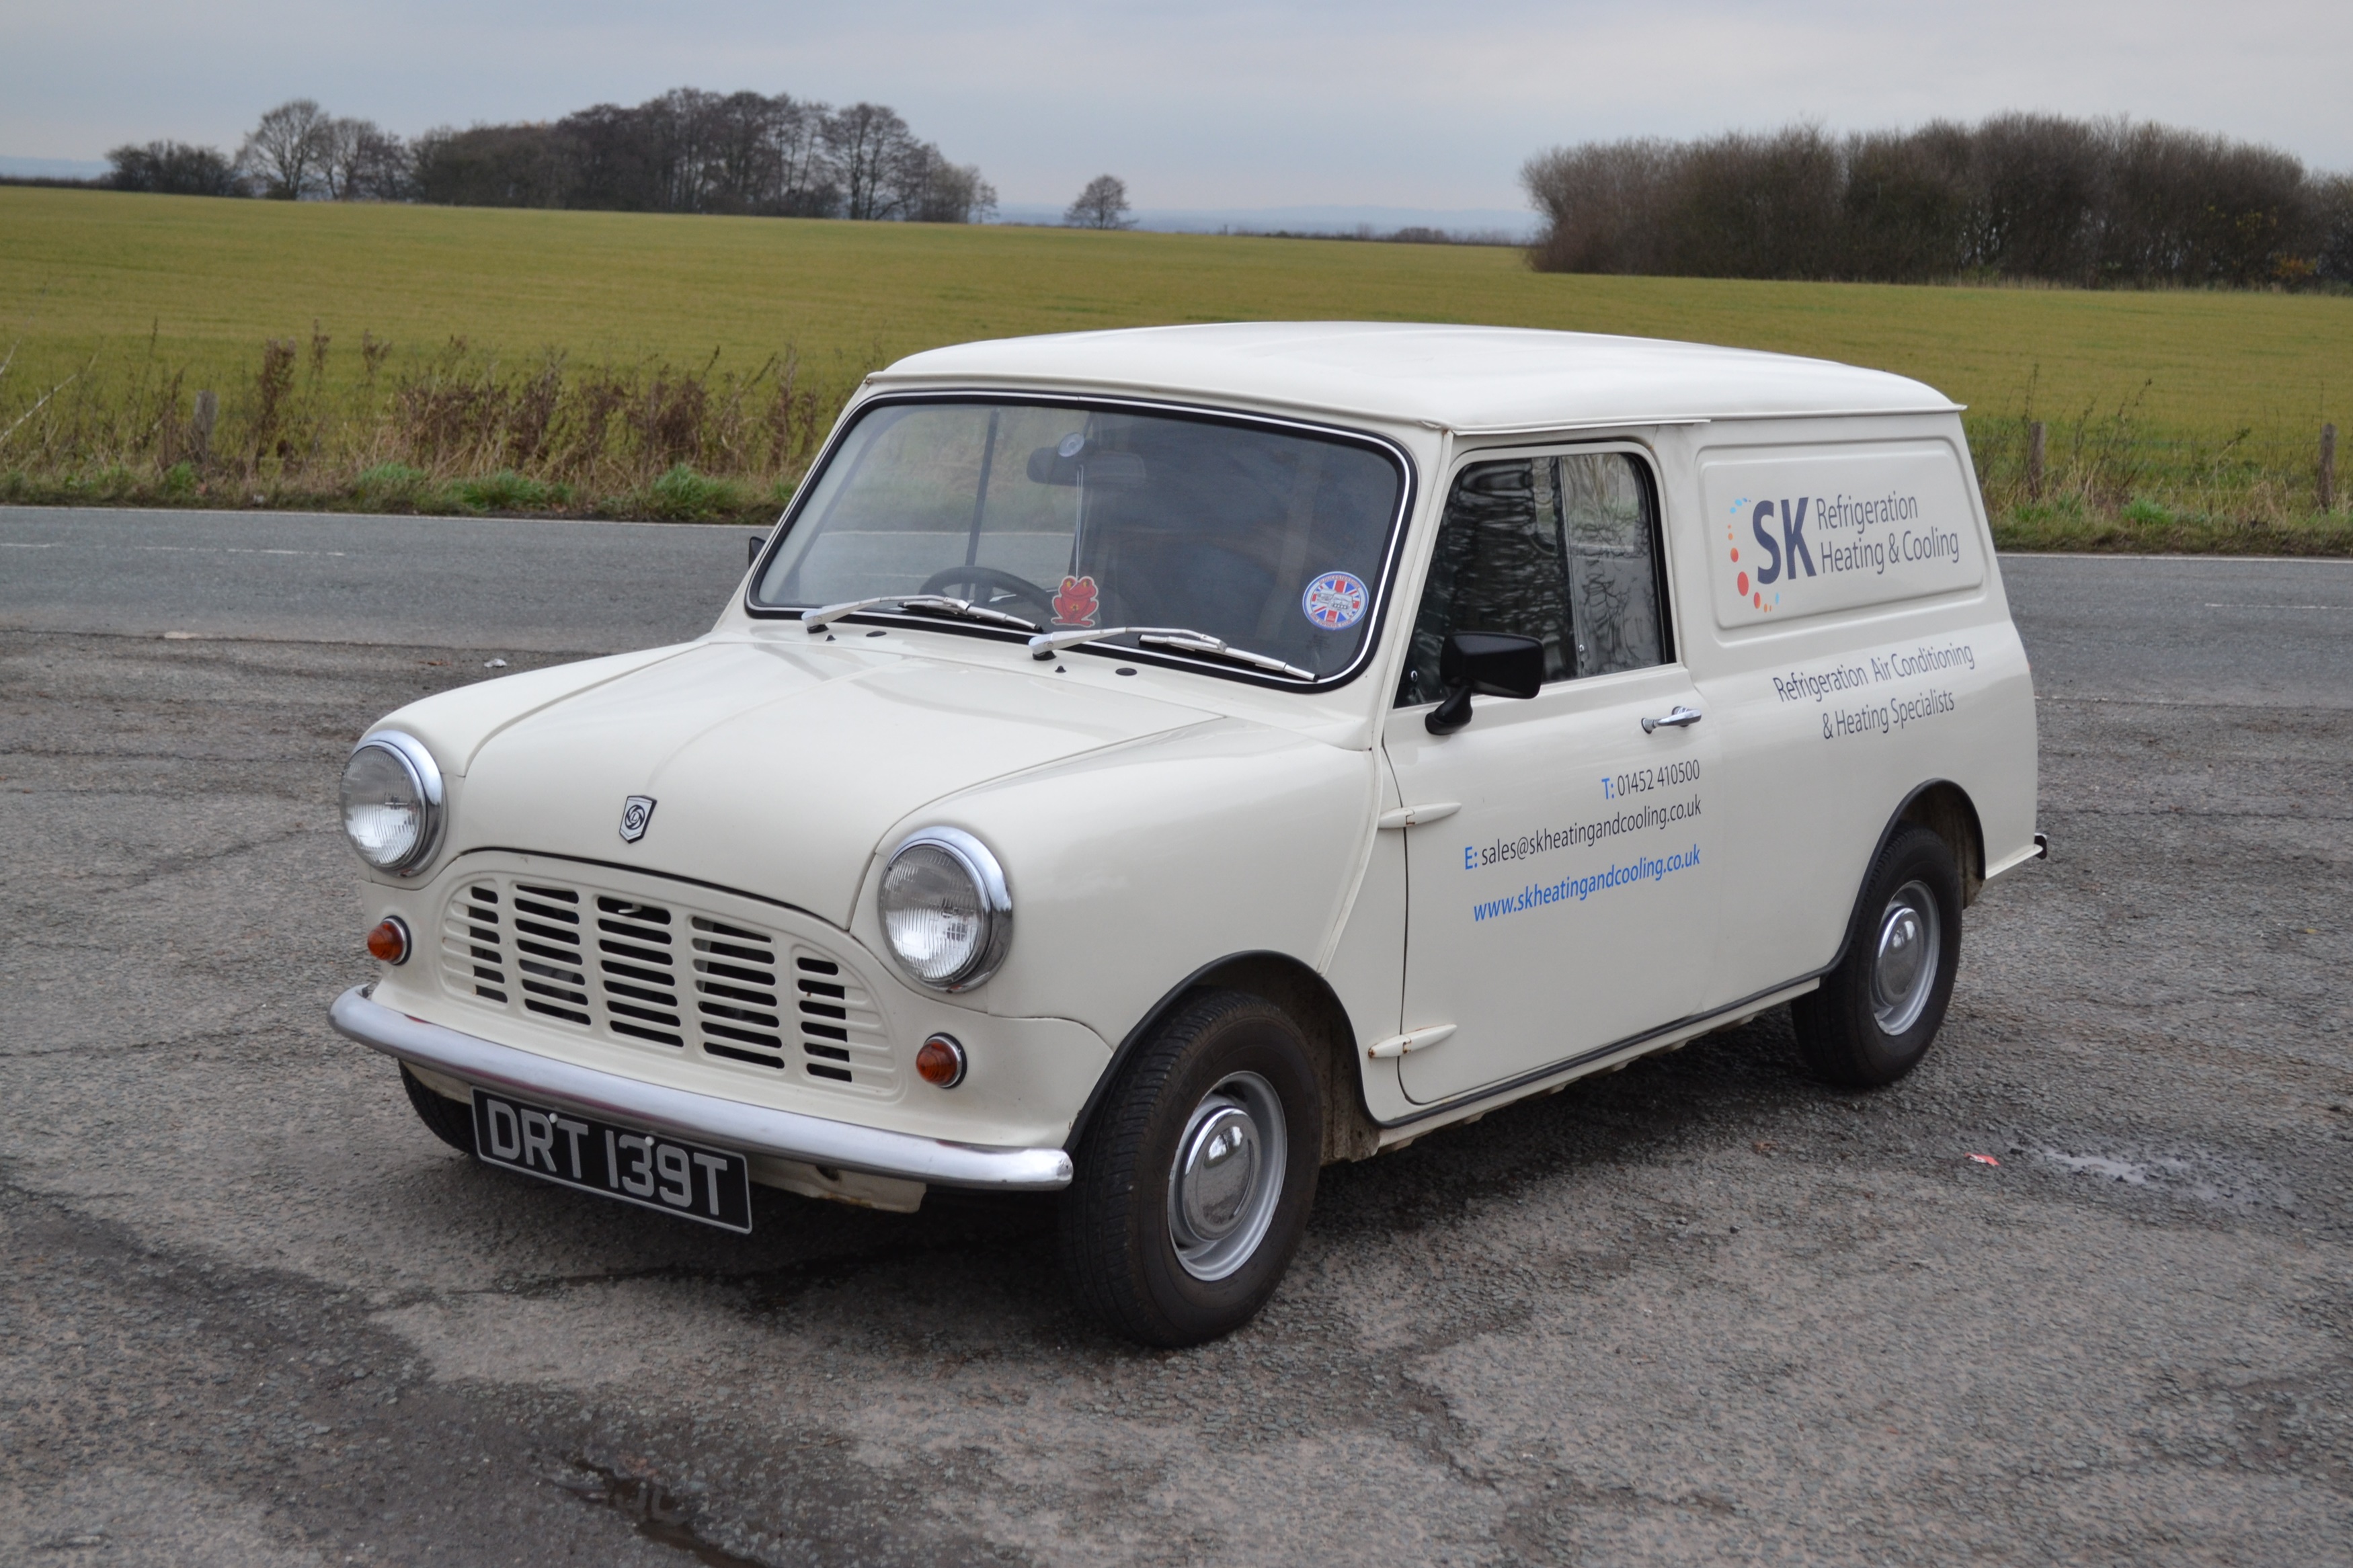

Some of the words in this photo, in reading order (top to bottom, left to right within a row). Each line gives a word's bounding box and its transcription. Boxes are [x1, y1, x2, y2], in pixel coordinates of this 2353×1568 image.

[1752, 497, 1817, 585] SK
[1817, 491, 1919, 534] Refrigeration
[1821, 538, 1884, 575] Heating
[1888, 532, 1900, 564] &
[1903, 526, 1960, 563] Cooling
[1773, 663, 1869, 703] Refrigeration
[1871, 656, 1892, 682] Air
[1890, 643, 1975, 679] Conditioning
[1823, 713, 1834, 739] &
[1835, 703, 1889, 737] Heating
[1890, 688, 1955, 729] Specialists
[1601, 778, 1615, 800] T:
[1617, 769, 1654, 796] 01452
[1657, 759, 1700, 788] 410500
[1464, 846, 1478, 870] E:
[1481, 794, 1702, 866] sales@skheatingandcooling.co.uk
[1473, 843, 1701, 922] www.skheatingandcooling.co.uk
[487, 1098, 589, 1179] DRT
[605, 1130, 727, 1216] 139T
